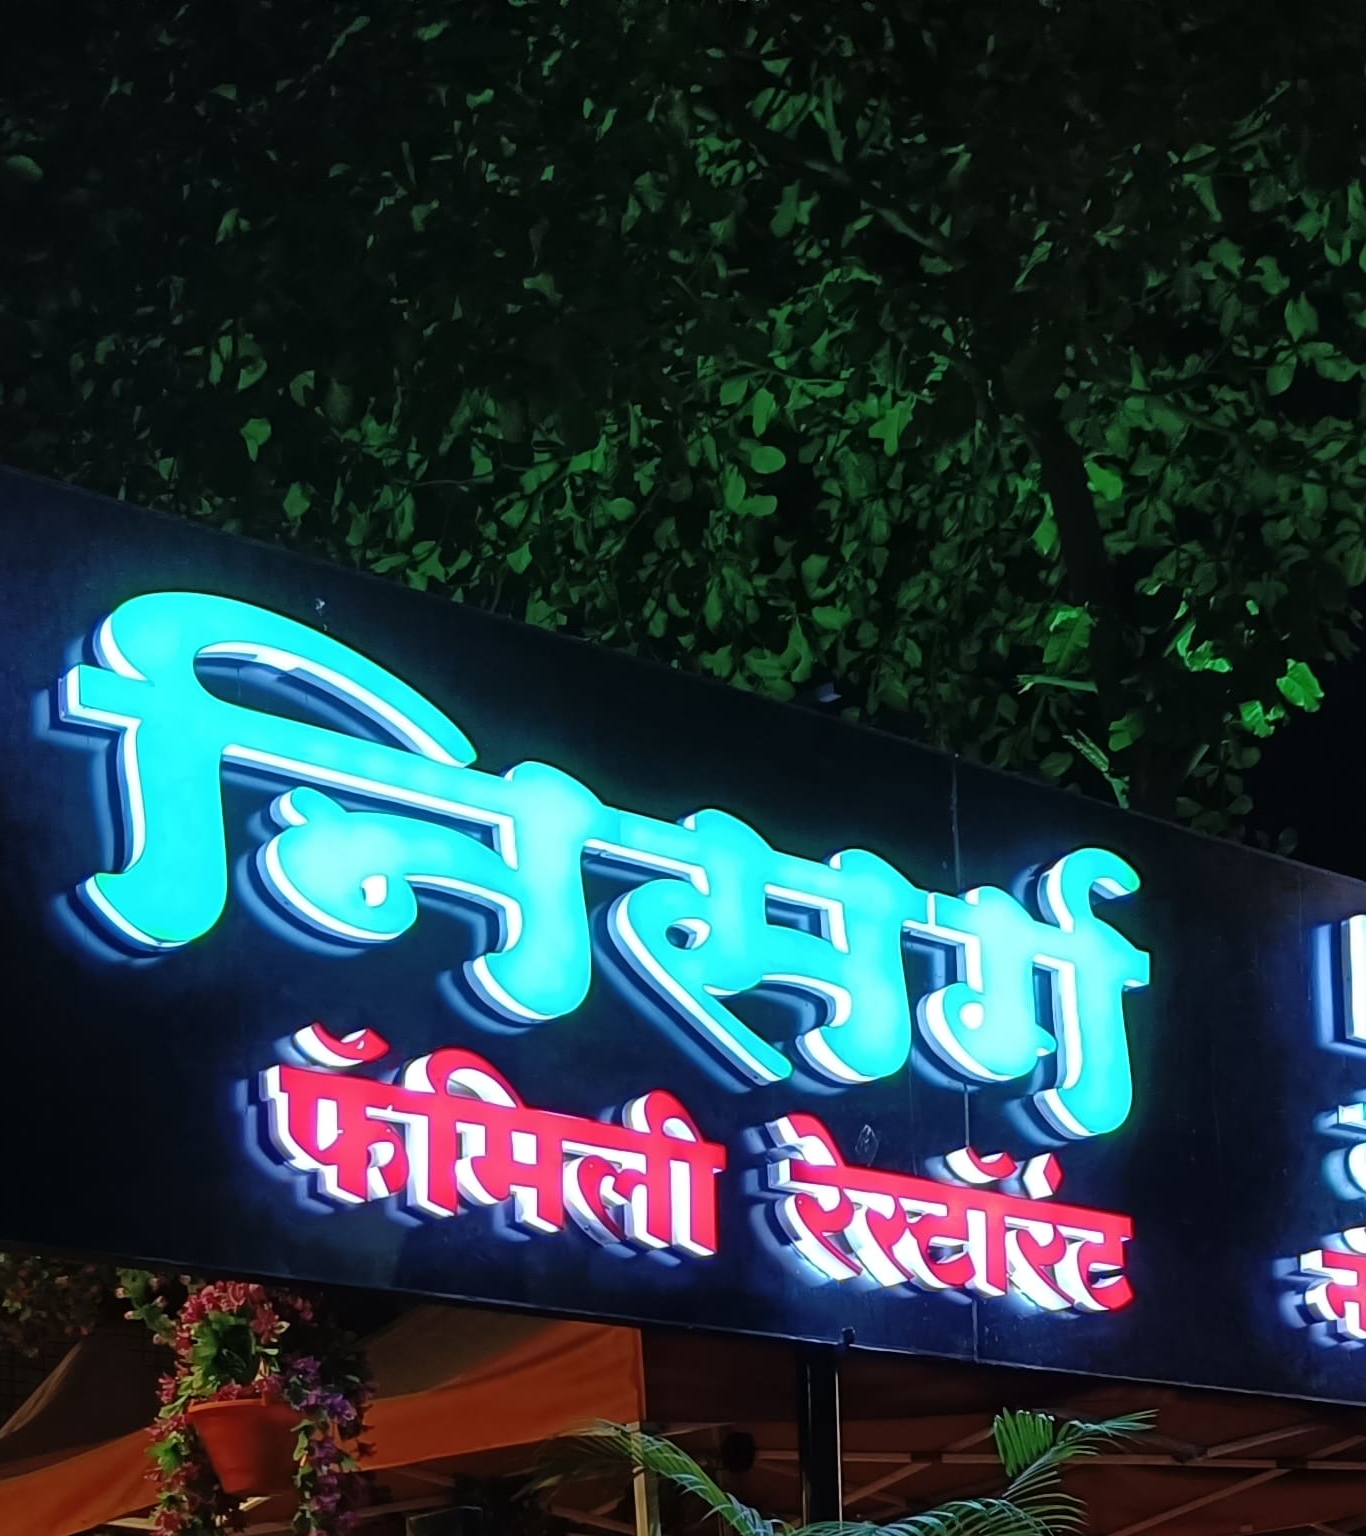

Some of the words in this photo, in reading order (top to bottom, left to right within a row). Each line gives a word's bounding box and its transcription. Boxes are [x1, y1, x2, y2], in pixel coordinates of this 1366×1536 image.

[61, 592, 1150, 1137] निसर्ग
[261, 1022, 725, 1257] फॅमिली
[766, 1113, 1135, 1313] रेस्टॉरंट
